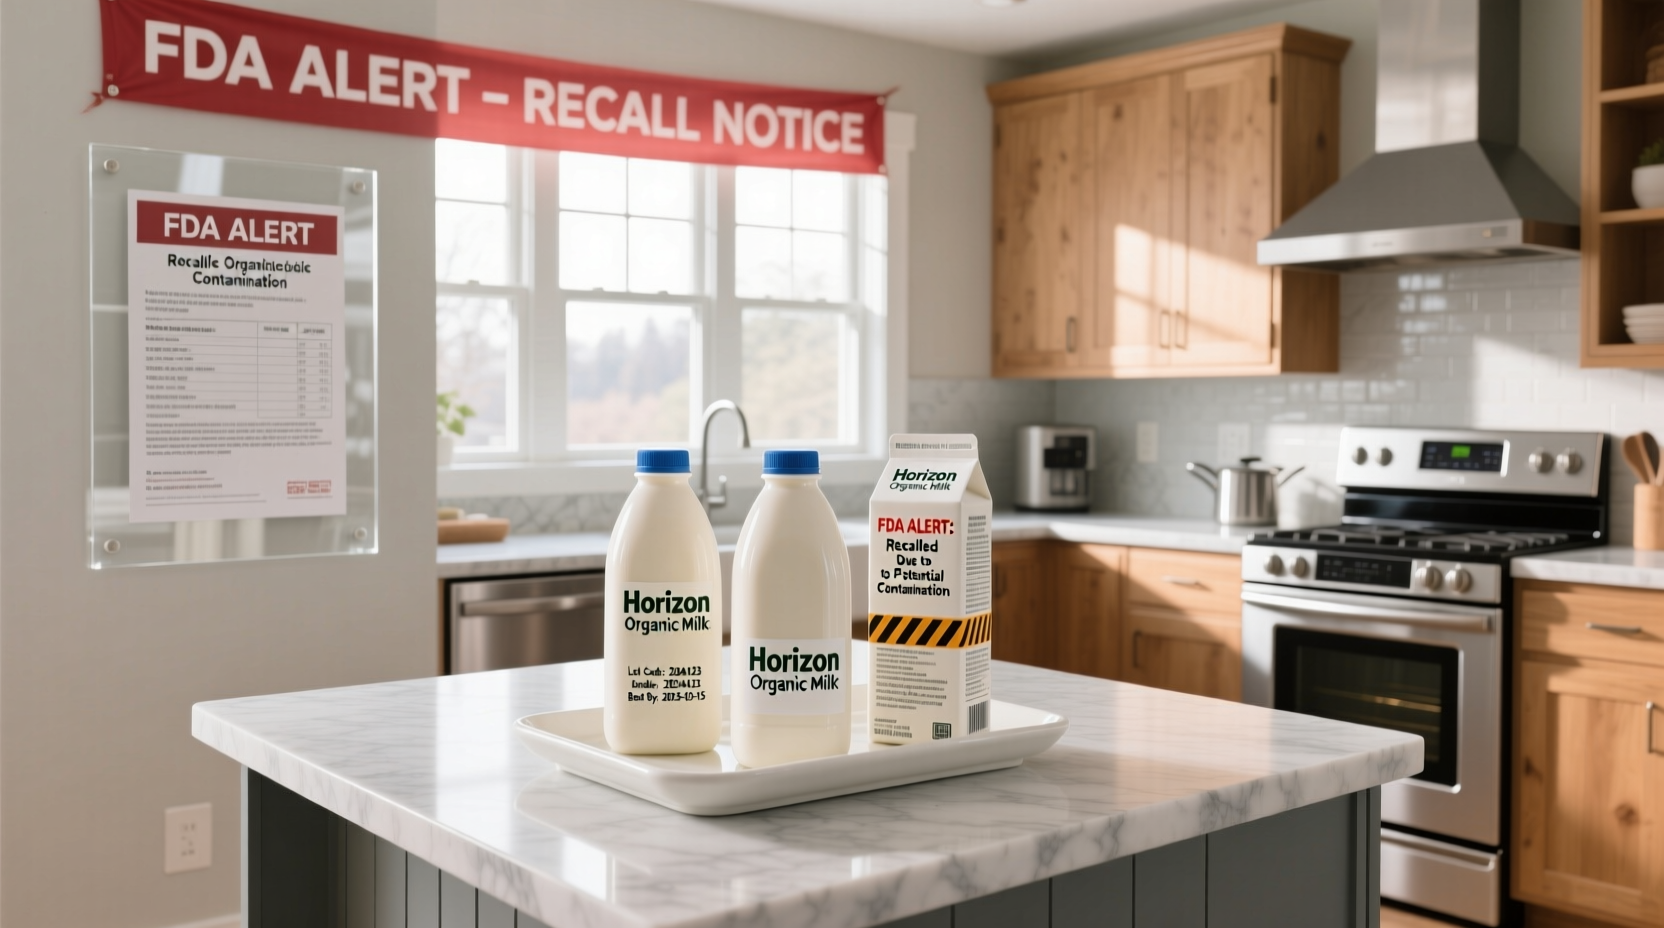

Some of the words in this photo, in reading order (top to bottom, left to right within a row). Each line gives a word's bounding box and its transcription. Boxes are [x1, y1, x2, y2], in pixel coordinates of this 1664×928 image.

[143, 19, 273, 91] FDA
[289, 44, 470, 115] ALERT
[523, 77, 701, 143] RECALL
[712, 99, 865, 155] NOTICE
[163, 211, 220, 241] FDA
[228, 217, 315, 246] ALERT
[892, 468, 957, 482] Horizon
[877, 517, 904, 534] FDA
[907, 518, 955, 535] ALERT:
[886, 538, 939, 553] Recalled
[881, 568, 890, 579] to
[623, 589, 710, 614] Horizon
[624, 616, 679, 635] Organic
[682, 615, 711, 632] Milk
[749, 646, 840, 672] Horizon
[750, 674, 807, 696] Organic
[810, 674, 839, 691] Milk
